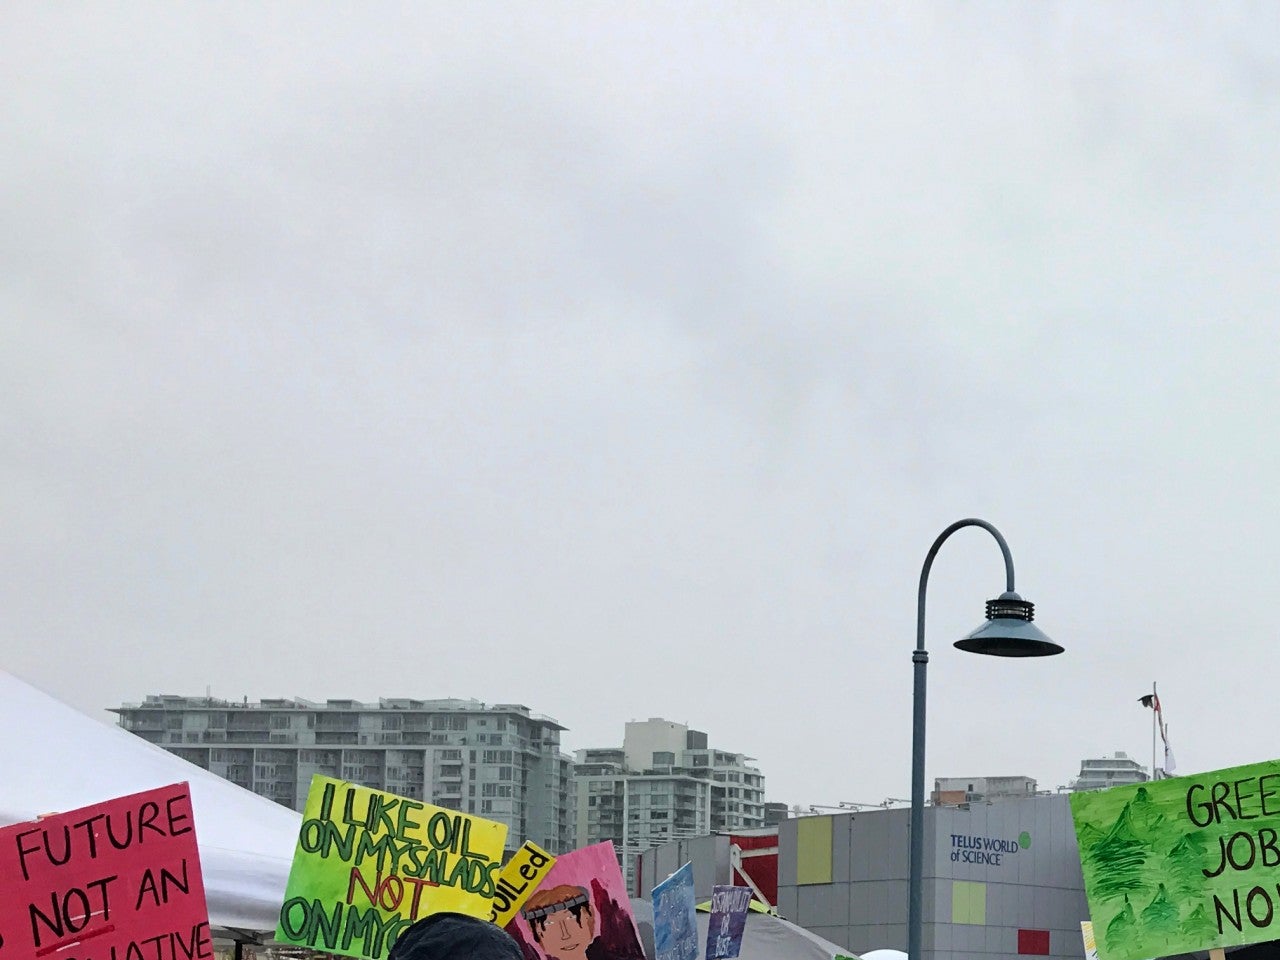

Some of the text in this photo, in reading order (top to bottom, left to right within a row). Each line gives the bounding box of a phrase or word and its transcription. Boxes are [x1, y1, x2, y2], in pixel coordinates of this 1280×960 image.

[16, 794, 192, 881] FUTURE
[320, 783, 490, 862] I LIKE OIL
[950, 834, 1019, 853] TELUS WORLD
[950, 849, 1001, 866] of SCIENCE
[300, 818, 500, 899] ON MY SALADS
[346, 866, 440, 920] NOT
[29, 859, 189, 948] NOT AN
[280, 896, 344, 949] ON
[341, 905, 402, 959] MY
